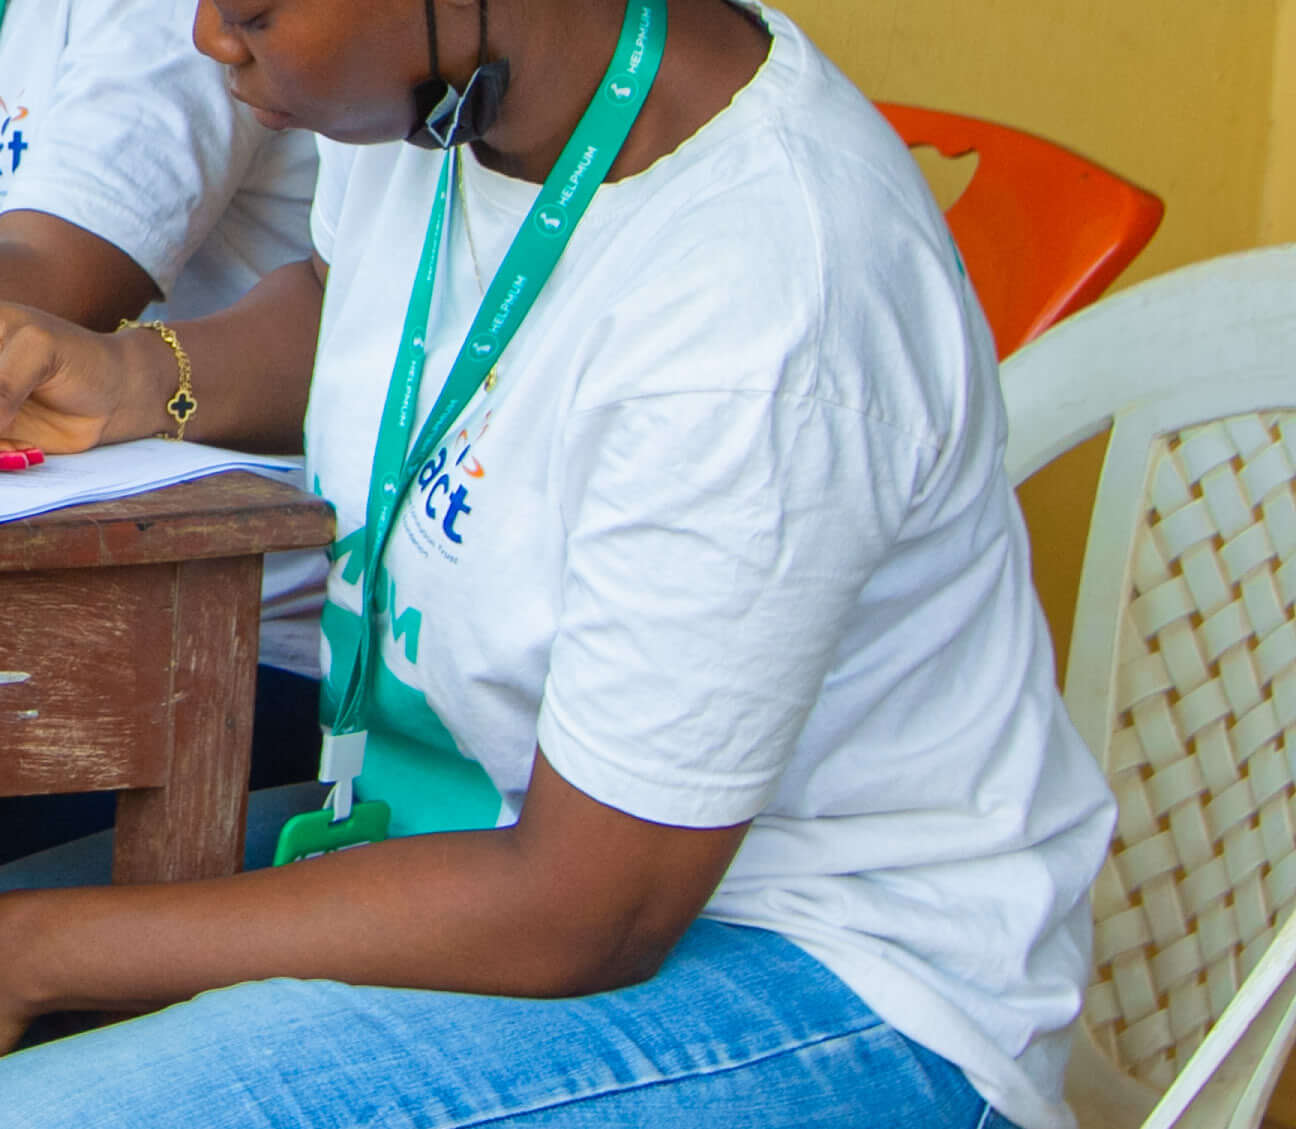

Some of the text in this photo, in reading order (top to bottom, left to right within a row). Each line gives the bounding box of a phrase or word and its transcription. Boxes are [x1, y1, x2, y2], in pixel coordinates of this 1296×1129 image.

[627, 6, 652, 75] HELPMUM
[559, 145, 598, 207] HELPMUM
[489, 274, 528, 334] HELPMUM
[399, 359, 417, 427] HELPMUM
[418, 447, 472, 545] act
